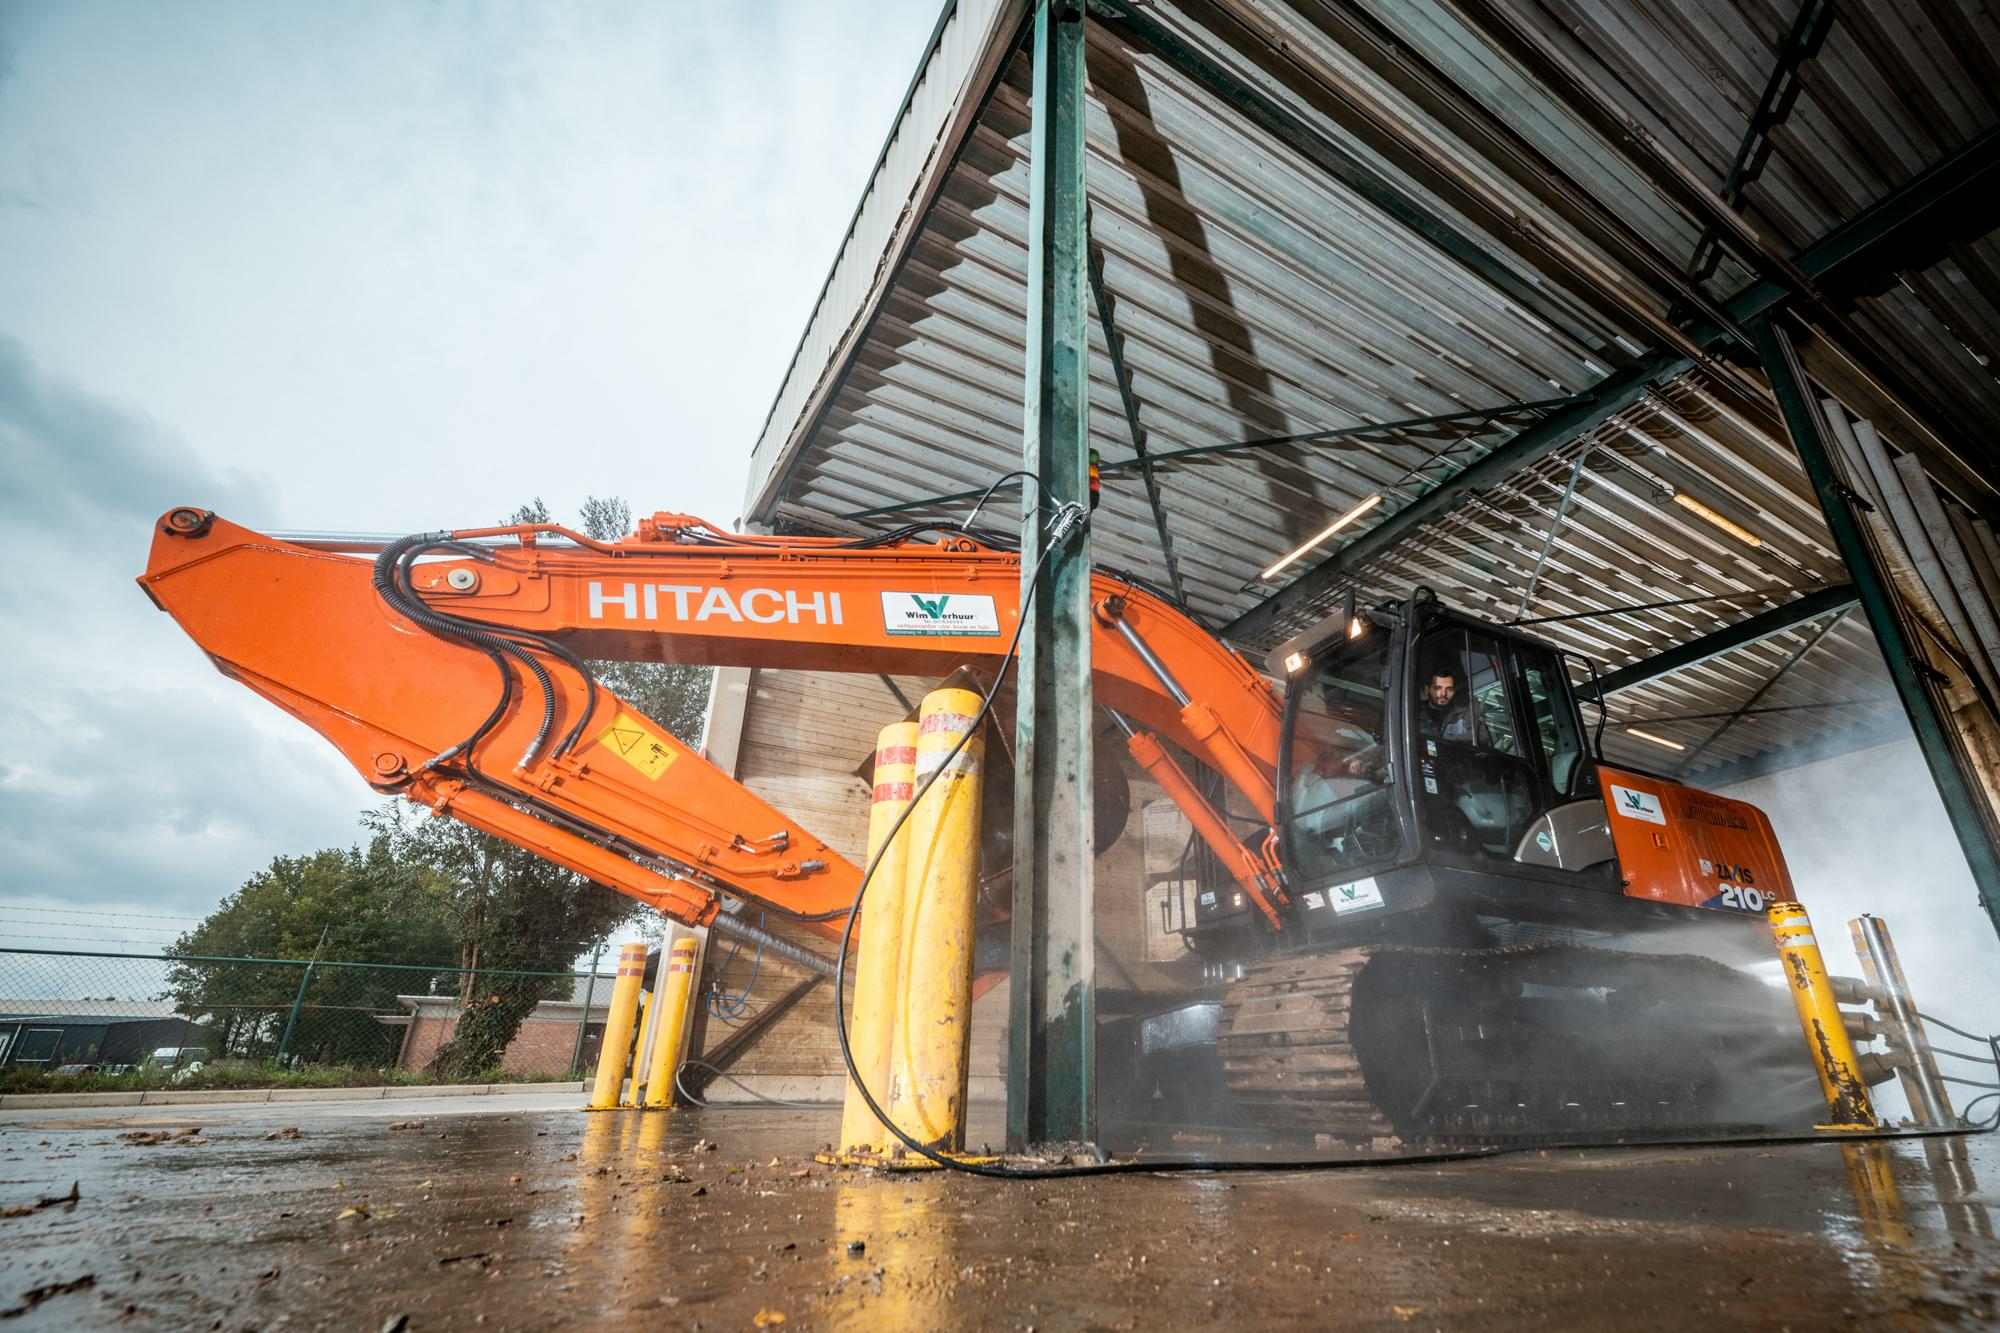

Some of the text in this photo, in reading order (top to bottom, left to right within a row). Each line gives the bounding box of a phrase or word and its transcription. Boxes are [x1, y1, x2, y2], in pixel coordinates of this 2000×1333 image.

[588, 581, 844, 625] HITACHI
[905, 611, 928, 619] Wim
[1715, 863, 1754, 885] ZAXIS
[1718, 882, 1764, 912] 210
